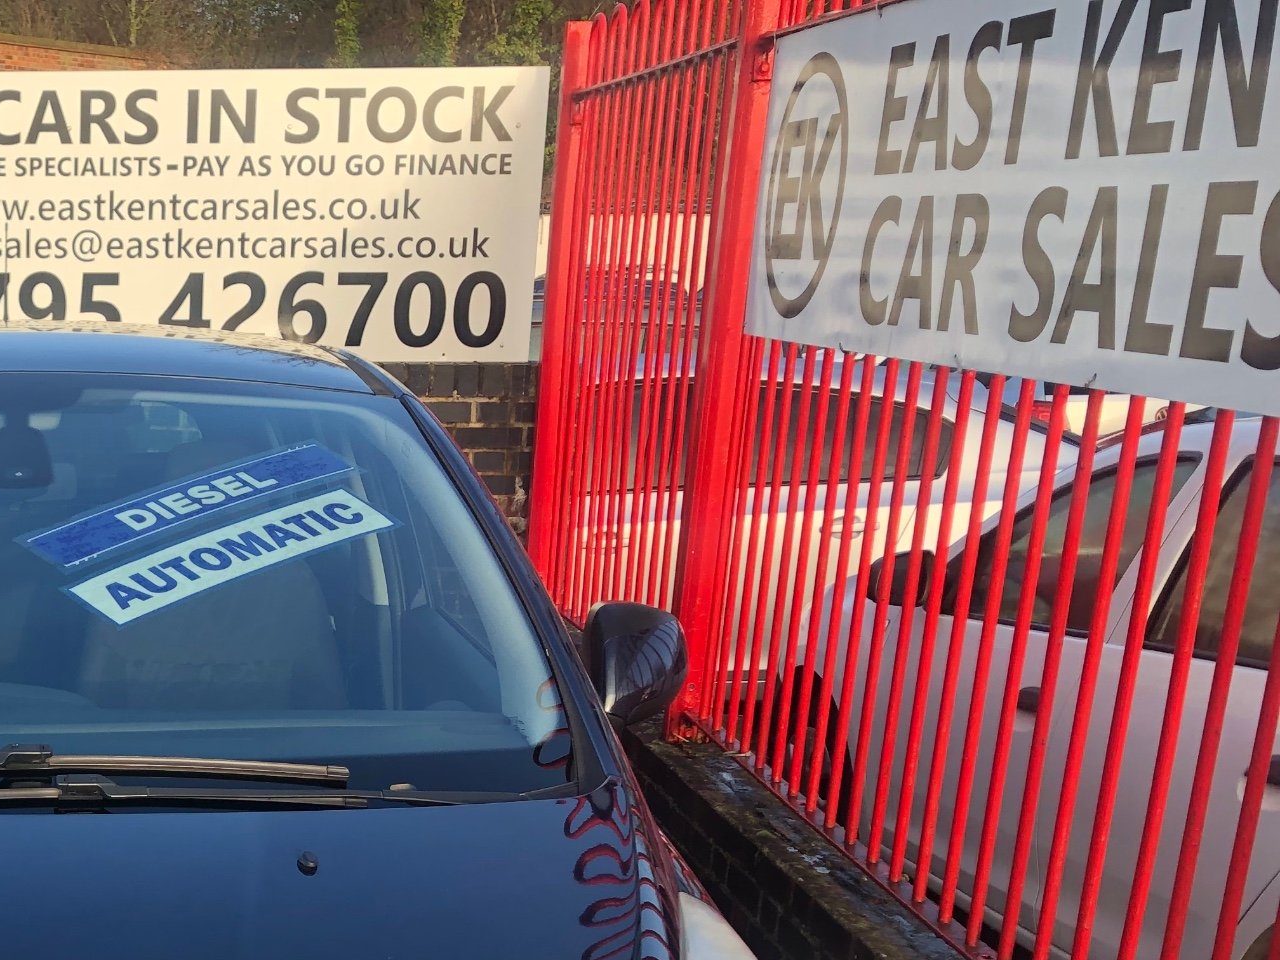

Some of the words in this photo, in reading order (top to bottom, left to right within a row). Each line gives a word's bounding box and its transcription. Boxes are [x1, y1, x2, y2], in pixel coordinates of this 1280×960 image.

[186, 88, 258, 144] IN
[284, 85, 515, 144] STOCK
[874, 8, 1057, 176] EAST
[237, 154, 272, 177] AS
[280, 154, 336, 177] YOU
[345, 154, 385, 177] GO
[394, 153, 513, 176] FINANCE
[859, 193, 990, 336] CAR
[158, 271, 507, 347] 426700
[114, 471, 279, 531] DIESEL
[104, 502, 364, 610] AUTOMATIC
